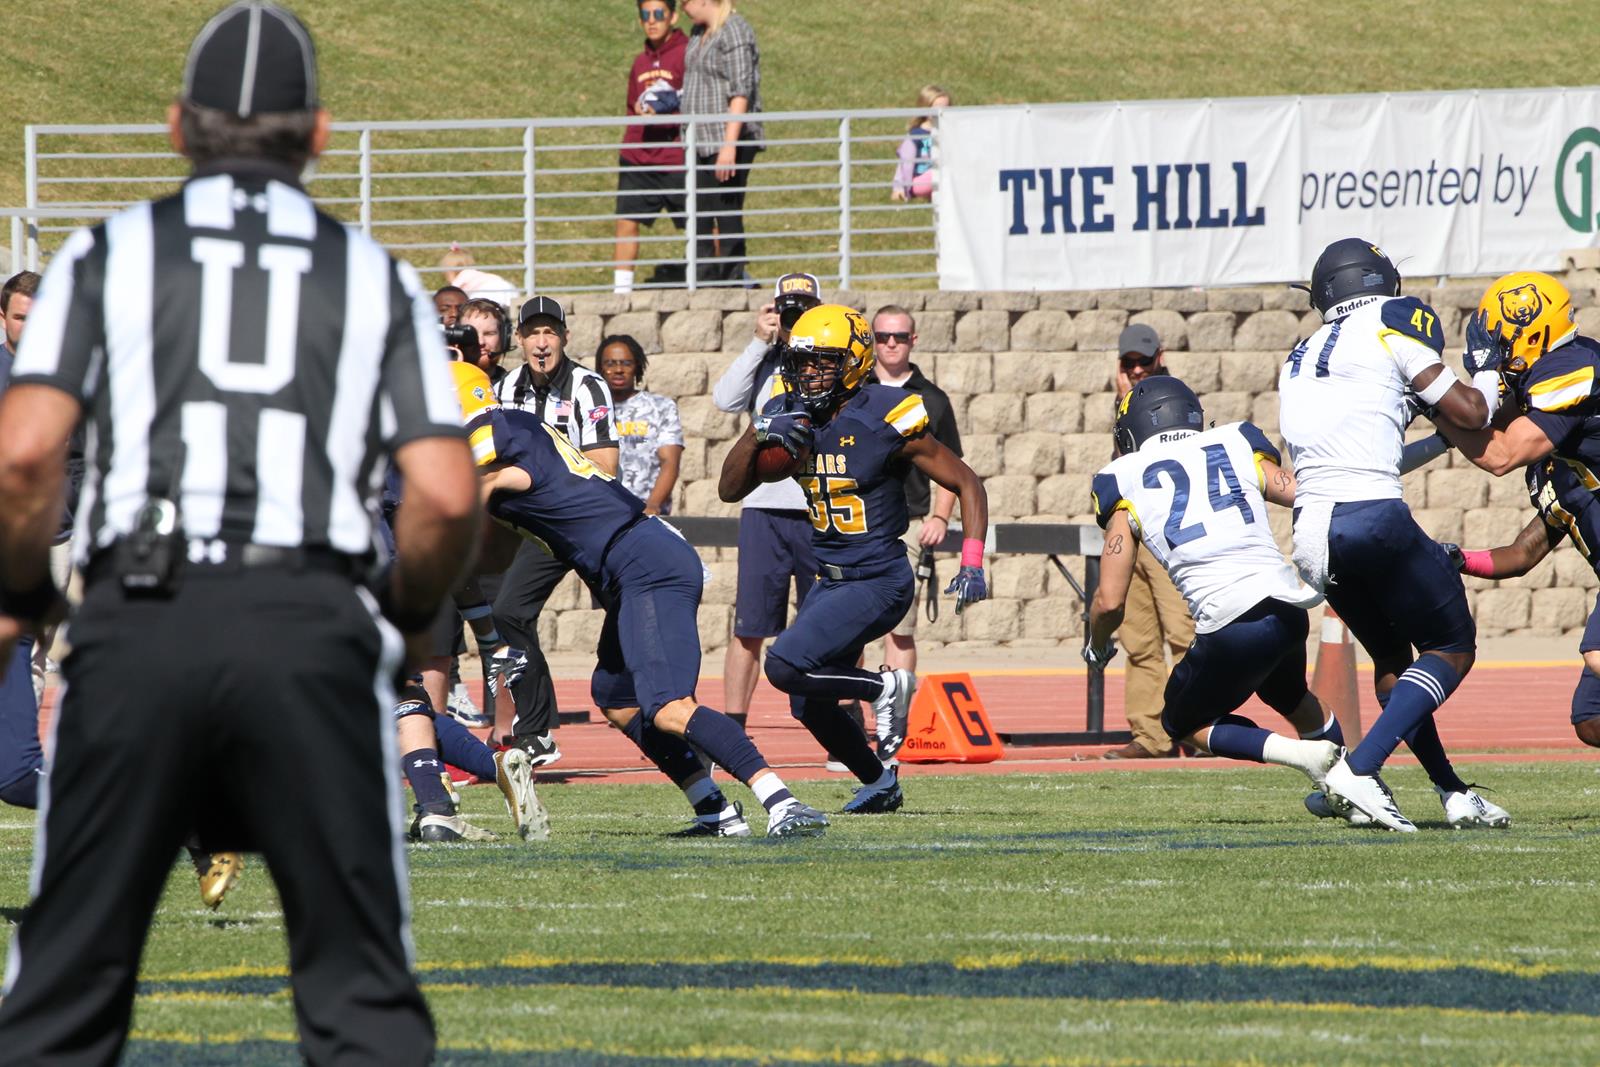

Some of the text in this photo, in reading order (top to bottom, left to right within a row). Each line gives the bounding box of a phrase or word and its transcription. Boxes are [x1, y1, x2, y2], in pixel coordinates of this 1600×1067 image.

[999, 153, 1539, 235] THE HILL presented by
[782, 278, 813, 293] UNC
[1336, 296, 1378, 316] Ridd
[190, 236, 312, 395] U
[1410, 308, 1435, 338] 47
[1160, 431, 1198, 444] Ridd
[798, 475, 868, 535] 35
[1142, 442, 1255, 552] 24
[942, 681, 993, 746] G
[906, 737, 947, 750] Gilman
